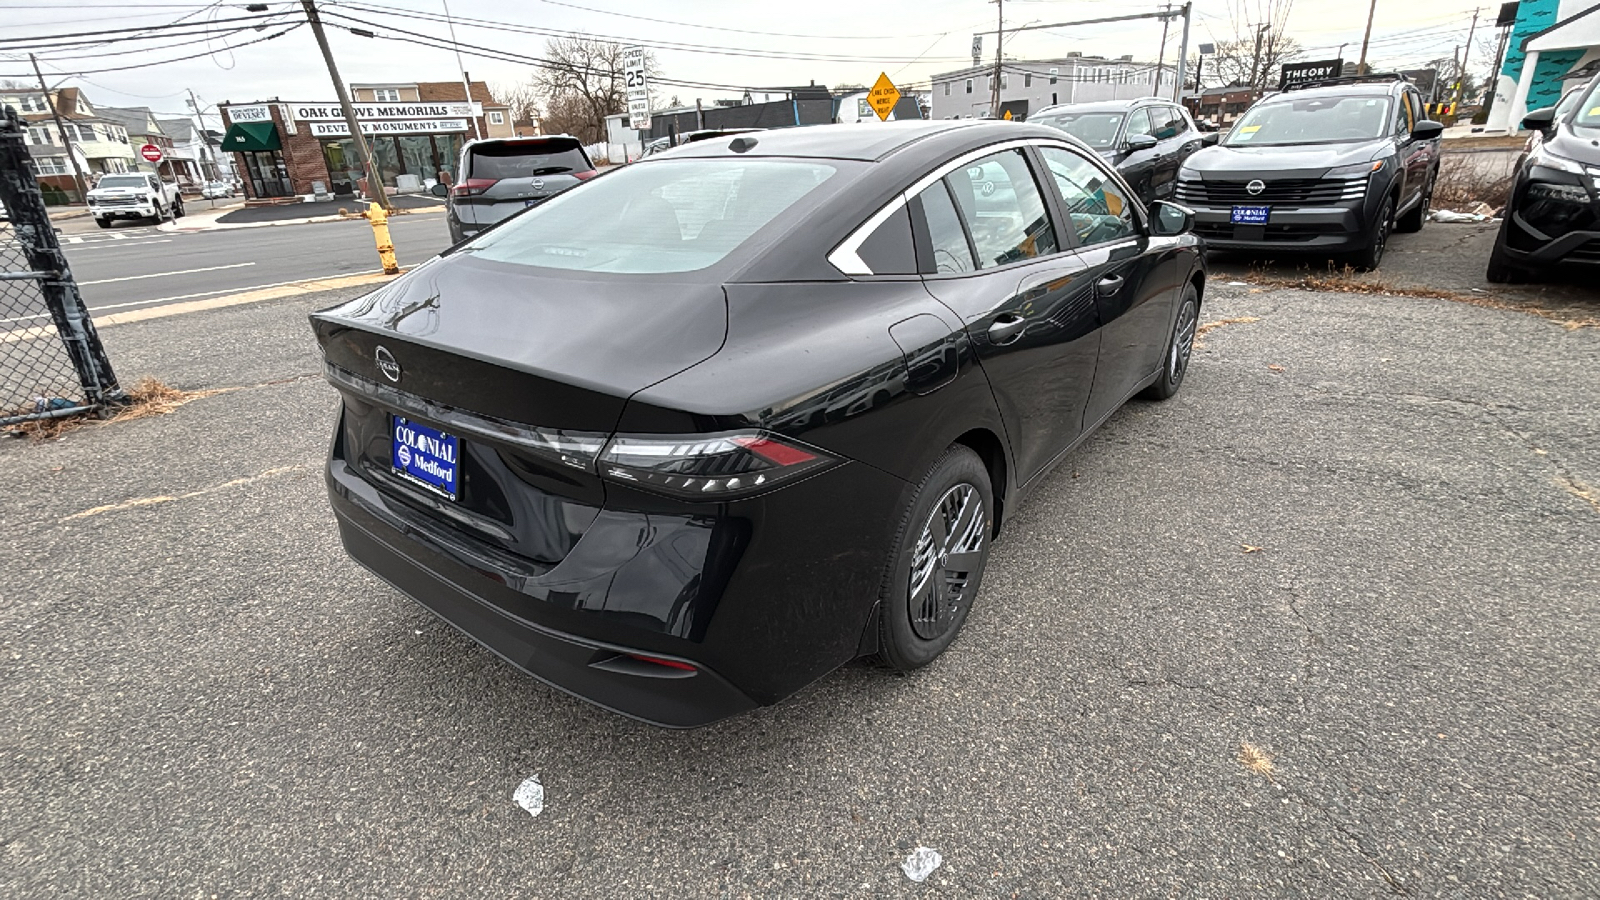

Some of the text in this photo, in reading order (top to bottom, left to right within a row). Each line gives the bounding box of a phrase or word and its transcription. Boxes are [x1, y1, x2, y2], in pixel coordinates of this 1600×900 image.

[624, 50, 643, 58] SPEED
[626, 59, 641, 67] LIMIT
[626, 69, 644, 87] 25
[1285, 66, 1333, 79] THEORY
[232, 112, 266, 121] DEVENEY
[298, 107, 329, 118] OAK
[376, 106, 449, 117] MEMORIALS
[316, 123, 369, 134] DEVEY
[372, 121, 438, 132] MONUMENTS
[396, 425, 456, 464] COLONIAL
[414, 453, 453, 483] Medford
